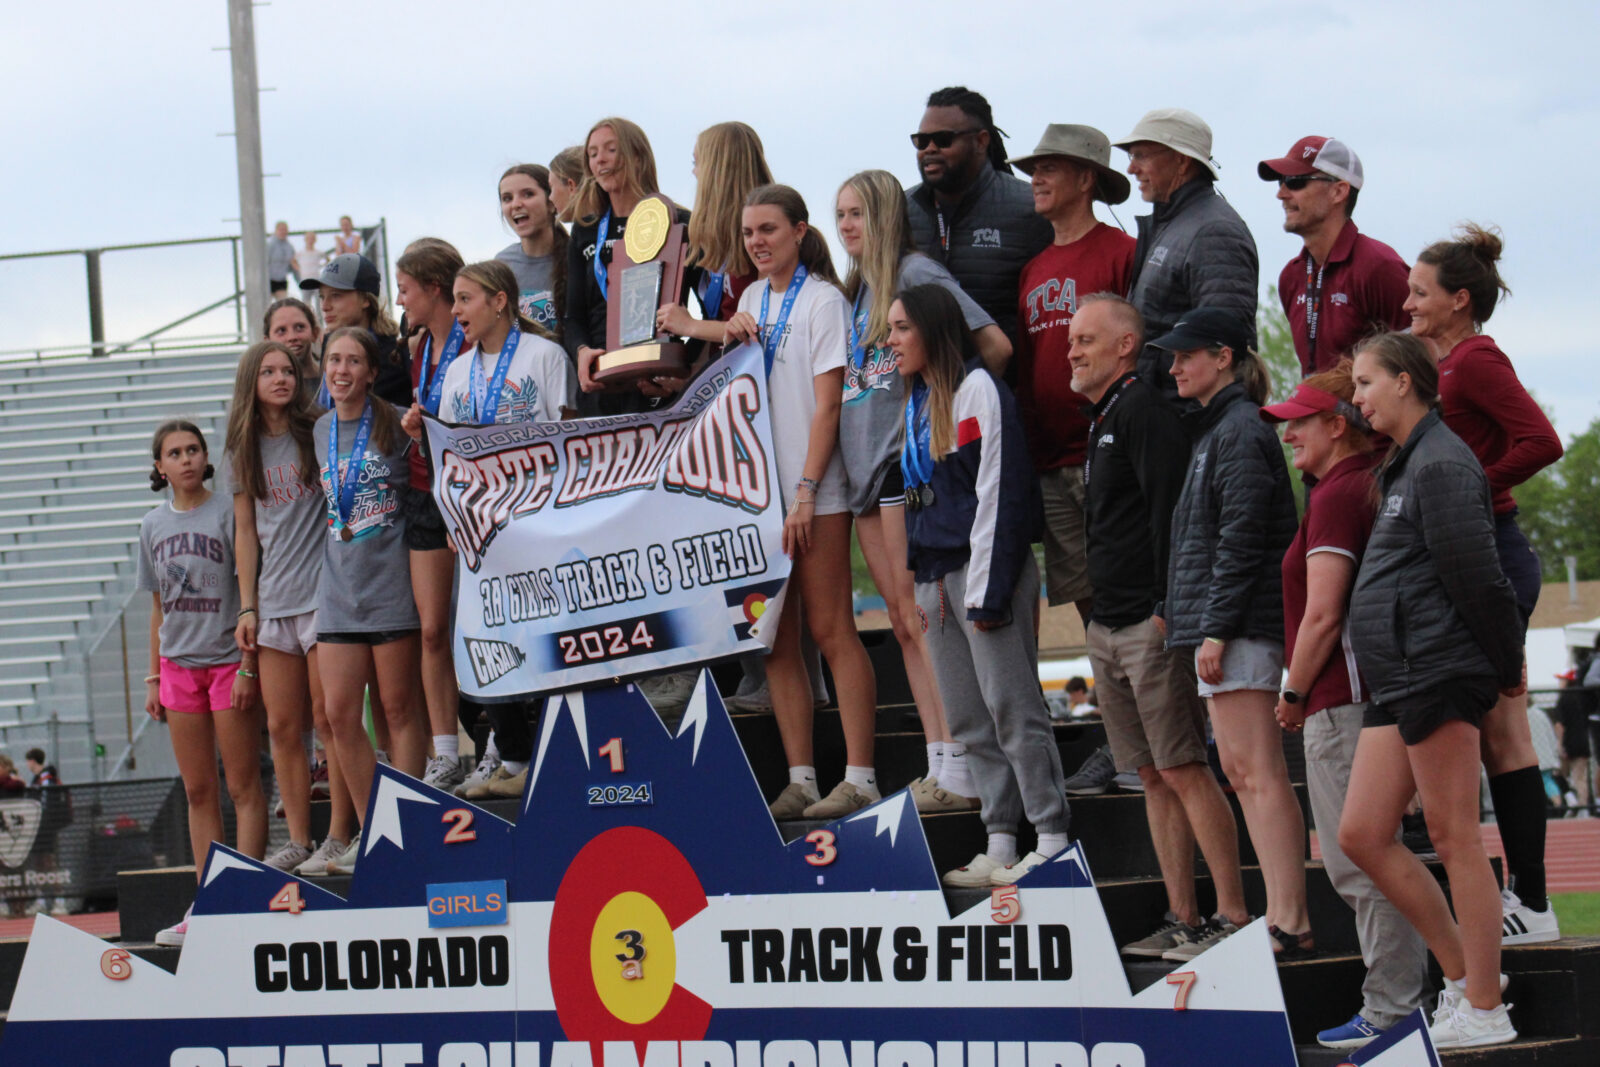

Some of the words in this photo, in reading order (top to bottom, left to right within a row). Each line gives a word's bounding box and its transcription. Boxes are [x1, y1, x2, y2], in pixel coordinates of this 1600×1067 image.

[972, 227, 1001, 246] TCA
[1026, 277, 1077, 325] TCA
[1055, 318, 1072, 327] FIEL
[447, 420, 579, 455] COLORADO
[360, 461, 391, 484] State
[348, 489, 398, 526] Field
[440, 441, 559, 573] STATE
[153, 532, 224, 564] TITANS
[480, 577, 506, 628] 3A
[506, 568, 560, 623] GIRLS
[555, 549, 646, 613] TRACK
[647, 544, 672, 595] &
[673, 524, 767, 589] FIELD
[559, 620, 655, 664] 2024
[469, 640, 515, 685] CHSAA
[598, 737, 625, 774] 1
[588, 785, 650, 805] 2024
[441, 807, 477, 845] 2
[804, 829, 838, 865] 3
[268, 881, 306, 915] 4
[428, 893, 503, 917] GIRLS
[990, 885, 1021, 926] 5
[253, 934, 509, 993] COLORADO
[614, 929, 646, 962] 3
[720, 926, 883, 985] TRACK
[893, 926, 928, 983] &
[936, 923, 1073, 983] FIELD
[100, 948, 133, 981] 6
[619, 955, 645, 981] a
[1166, 971, 1196, 1012] 7
